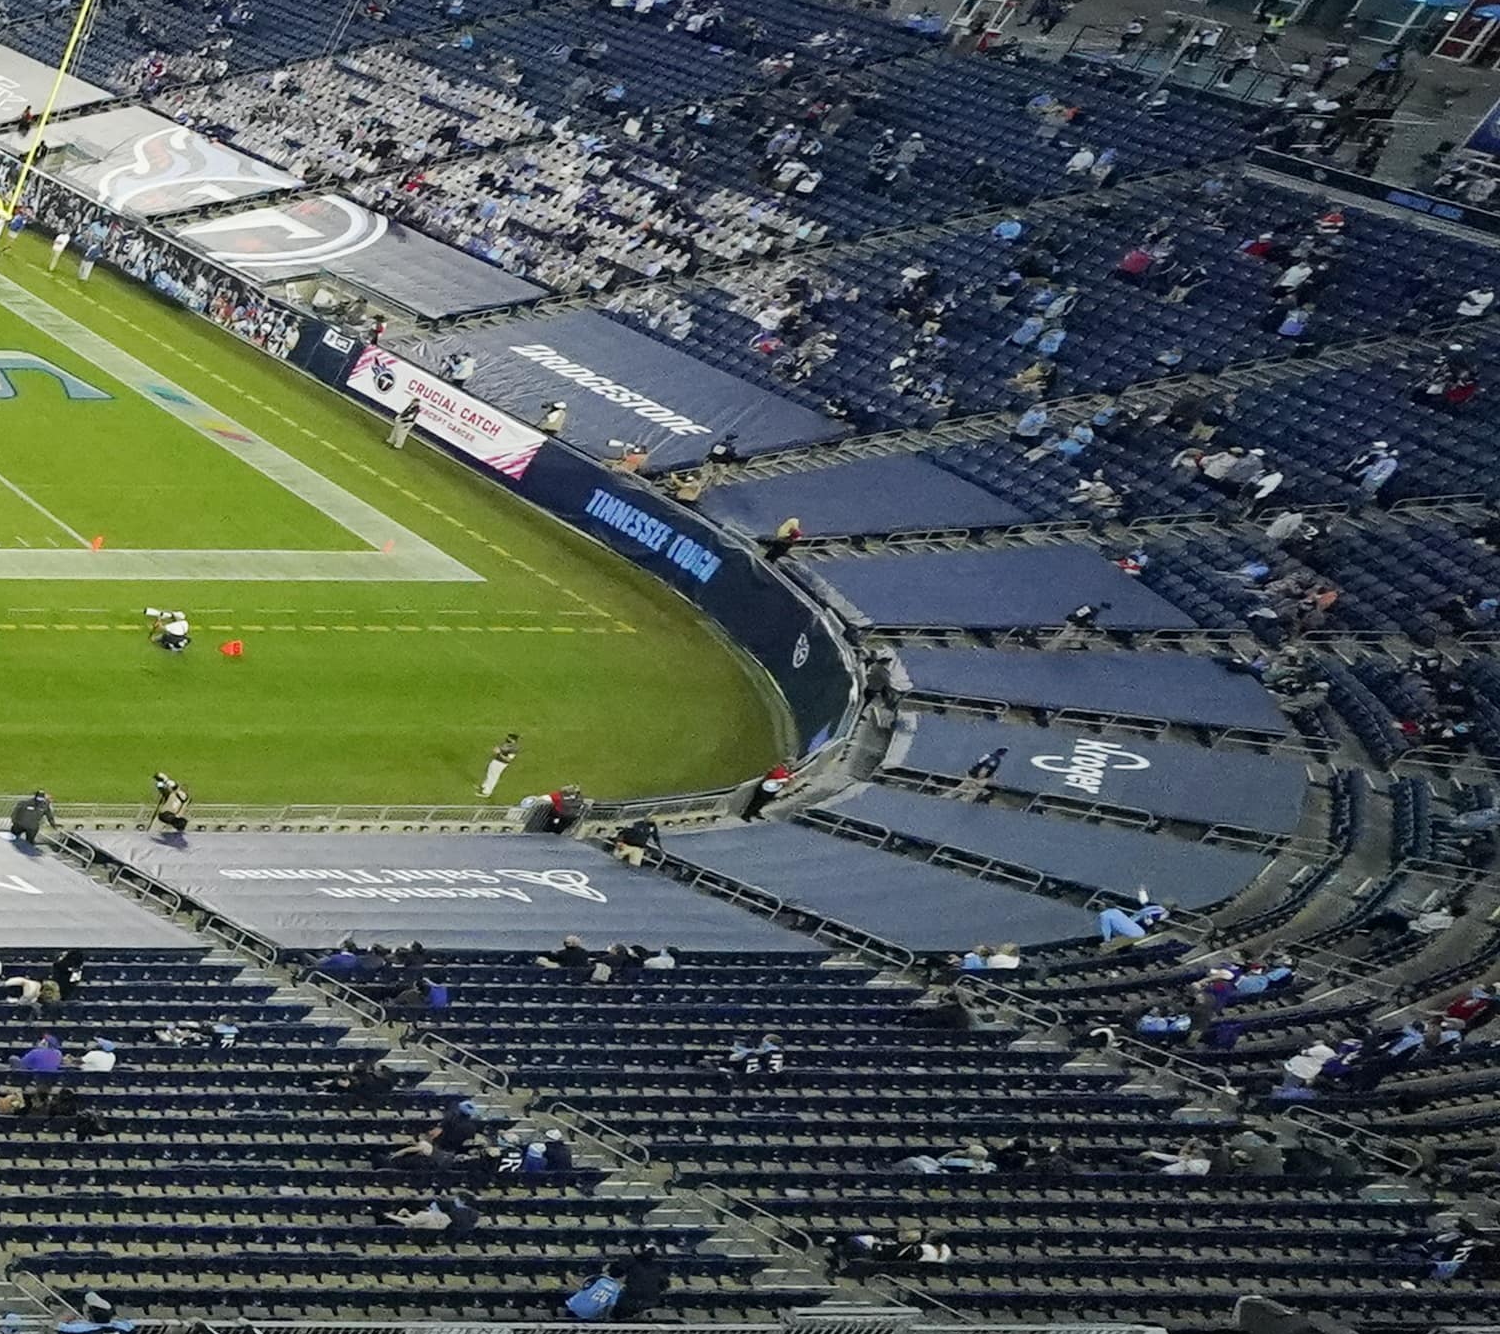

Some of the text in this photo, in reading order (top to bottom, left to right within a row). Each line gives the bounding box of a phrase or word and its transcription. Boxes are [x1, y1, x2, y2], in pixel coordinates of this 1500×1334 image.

[406, 378, 503, 438] CRUCIAL CATCH
[509, 343, 713, 437] BRIDGESTONE
[1030, 739, 1150, 794] Kroger
[219, 867, 387, 885] Thomas
[318, 886, 532, 903] Ascension
